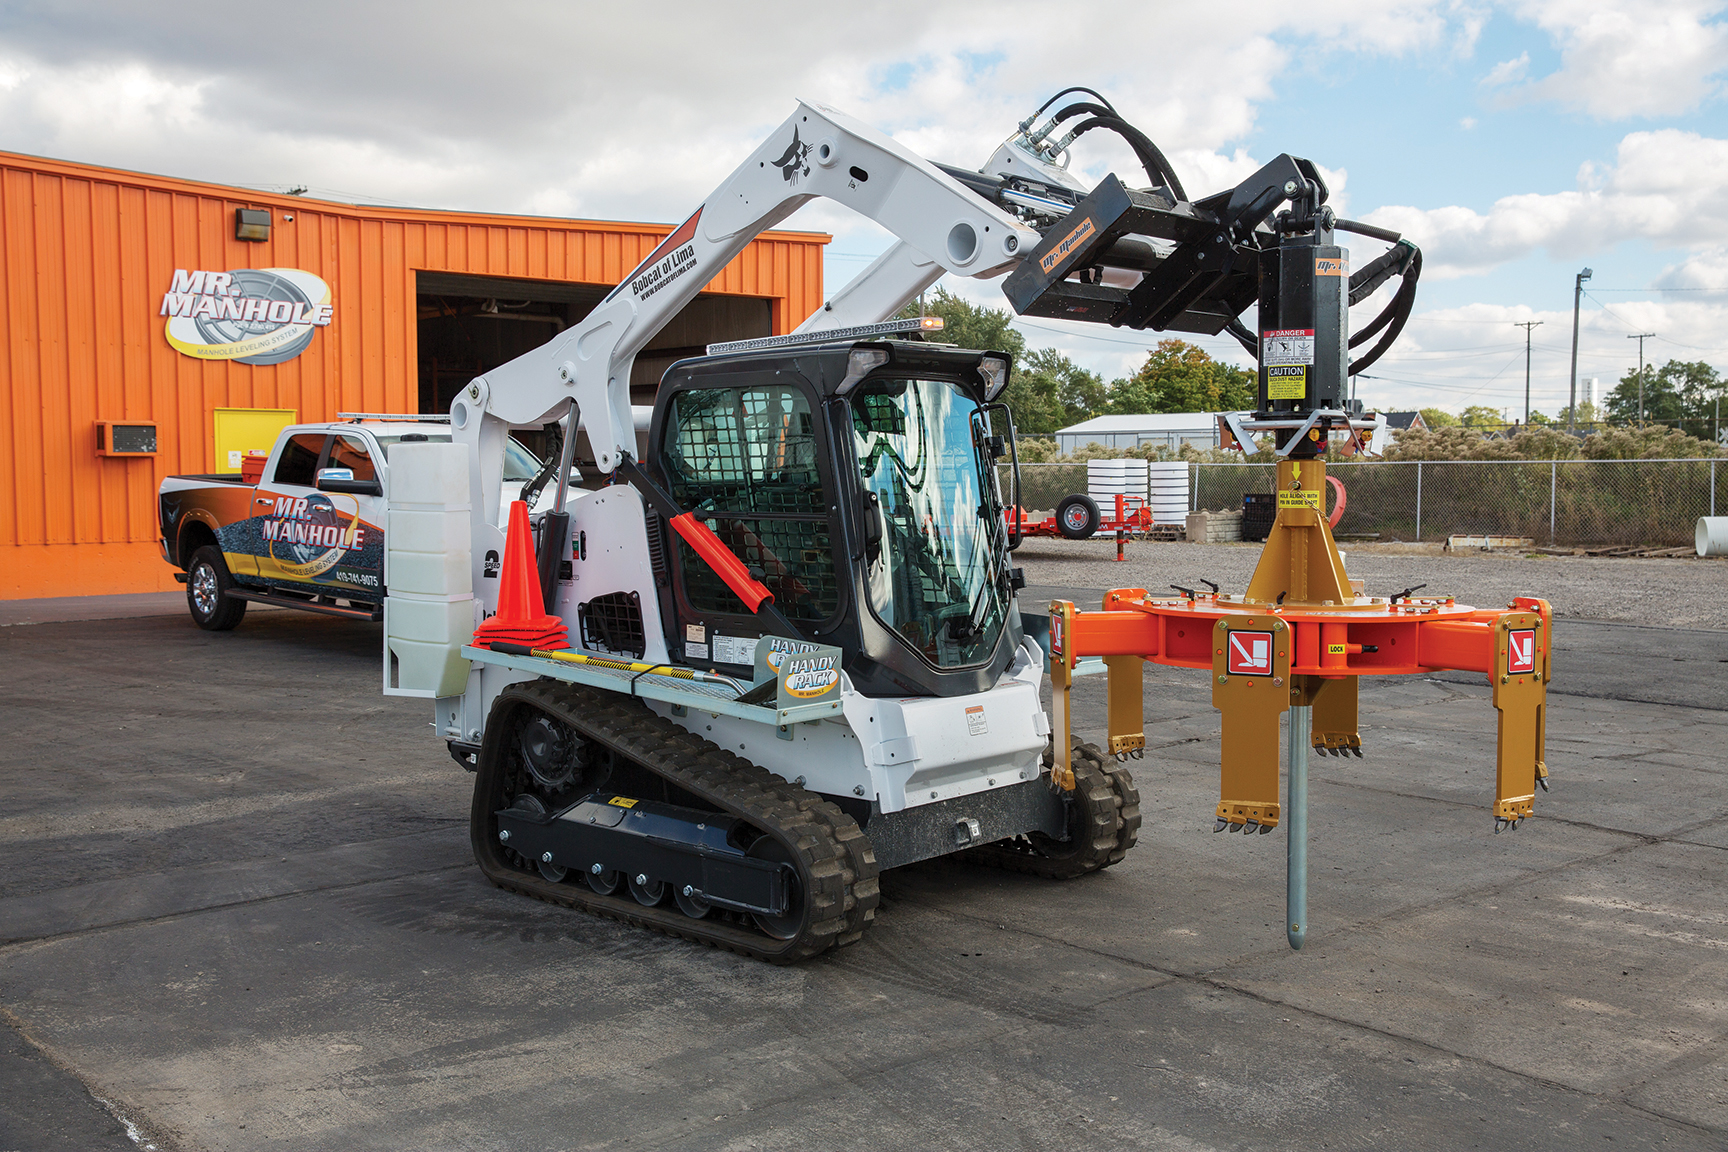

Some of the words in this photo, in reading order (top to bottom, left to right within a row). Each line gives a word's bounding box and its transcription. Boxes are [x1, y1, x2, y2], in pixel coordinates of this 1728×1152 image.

[1043, 252, 1059, 269] Mr.
[1059, 221, 1091, 254] Manhole
[631, 266, 662, 296] Bobcat
[662, 258, 671, 275] of
[671, 244, 694, 267] Lima
[1317, 260, 1336, 274] Mr.
[171, 269, 241, 297] MR.
[160, 293, 333, 326] MANHOLE
[196, 348, 234, 356] MANHOLE
[235, 340, 271, 355] LEVELING
[271, 327, 299, 345] SYSTEM
[1269, 367, 1304, 376] CAUTION
[272, 496, 313, 521] MR.
[262, 519, 365, 552] MANHOLE
[280, 564, 303, 576] MANHOLE
[303, 562, 323, 576] LEVELING
[322, 552, 339, 568] SYSTEM
[336, 571, 379, 587] 419-741-9075
[789, 655, 838, 675] HANDY
[793, 671, 833, 690] RACK
